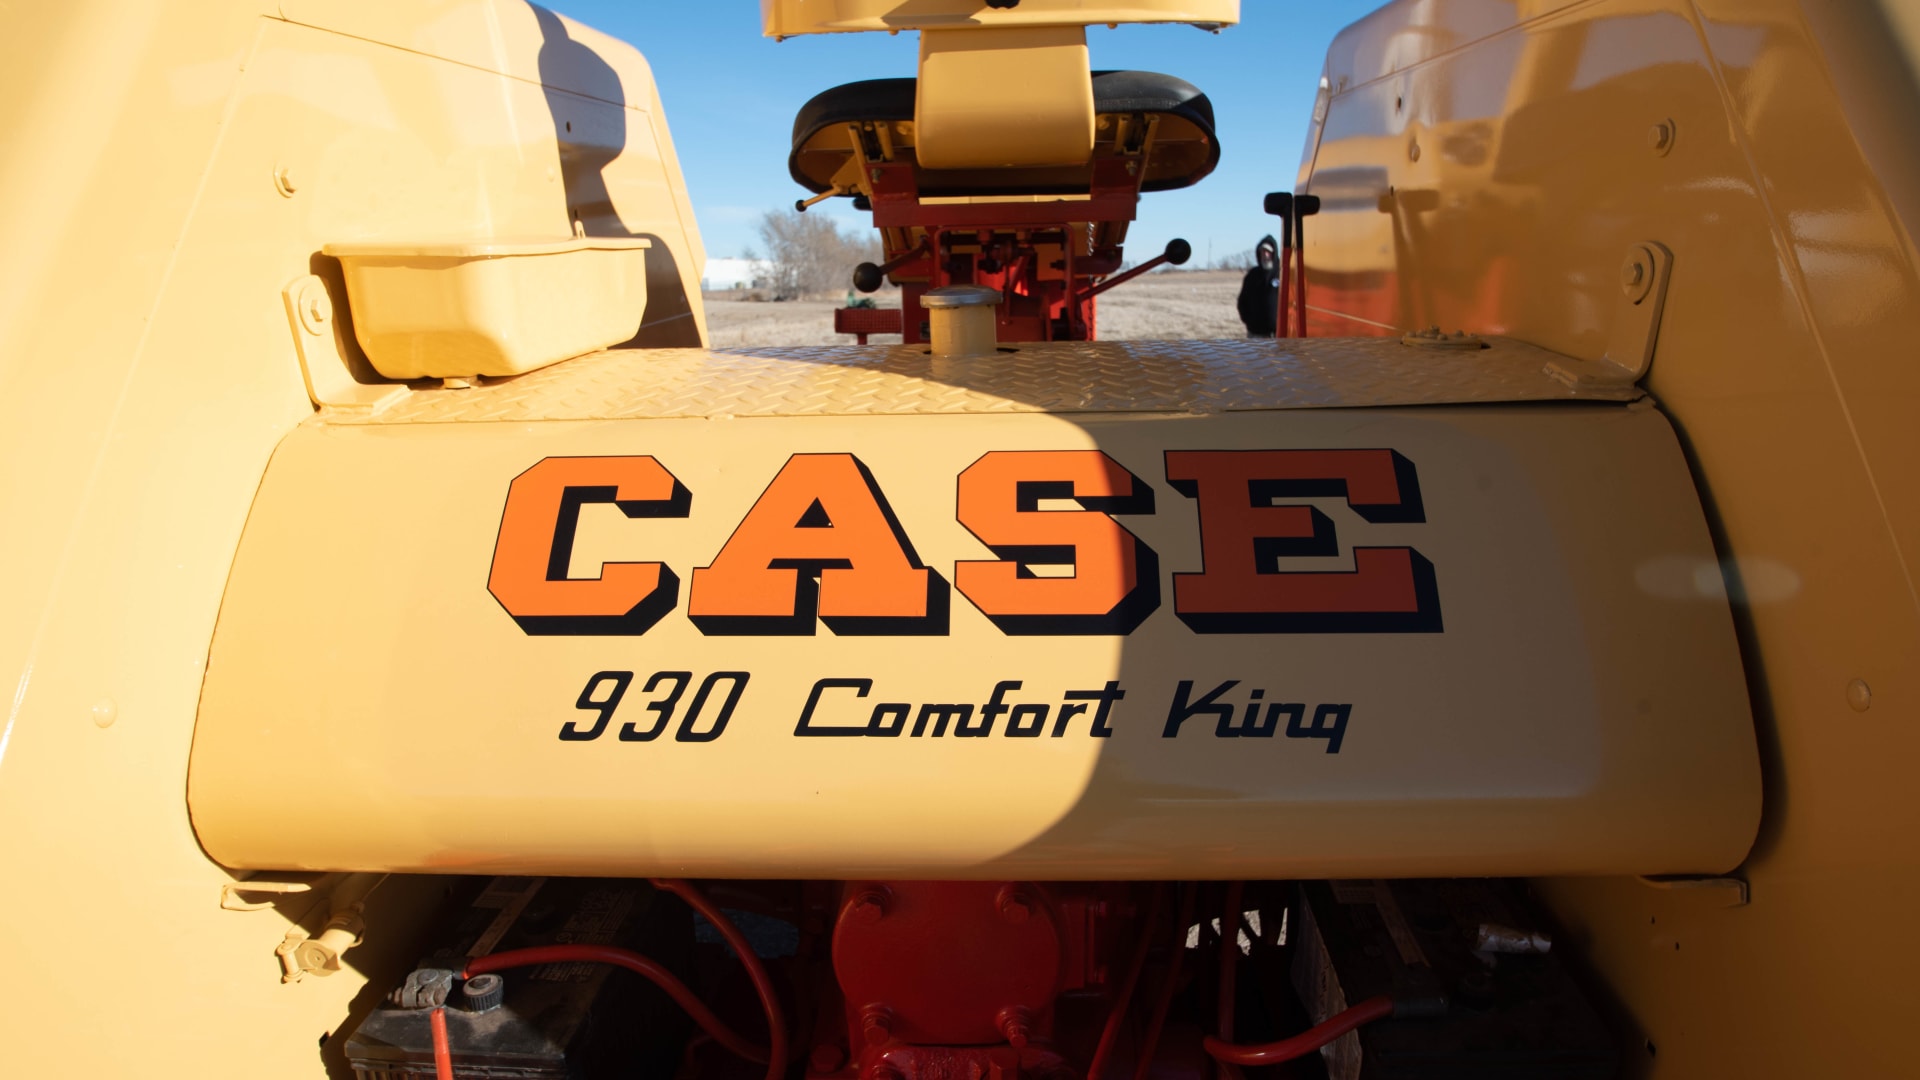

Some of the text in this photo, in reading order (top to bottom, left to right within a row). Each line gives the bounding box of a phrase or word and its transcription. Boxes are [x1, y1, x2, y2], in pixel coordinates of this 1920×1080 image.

[487, 448, 1444, 636] CASE
[558, 671, 1352, 754] 930 Comfort King
